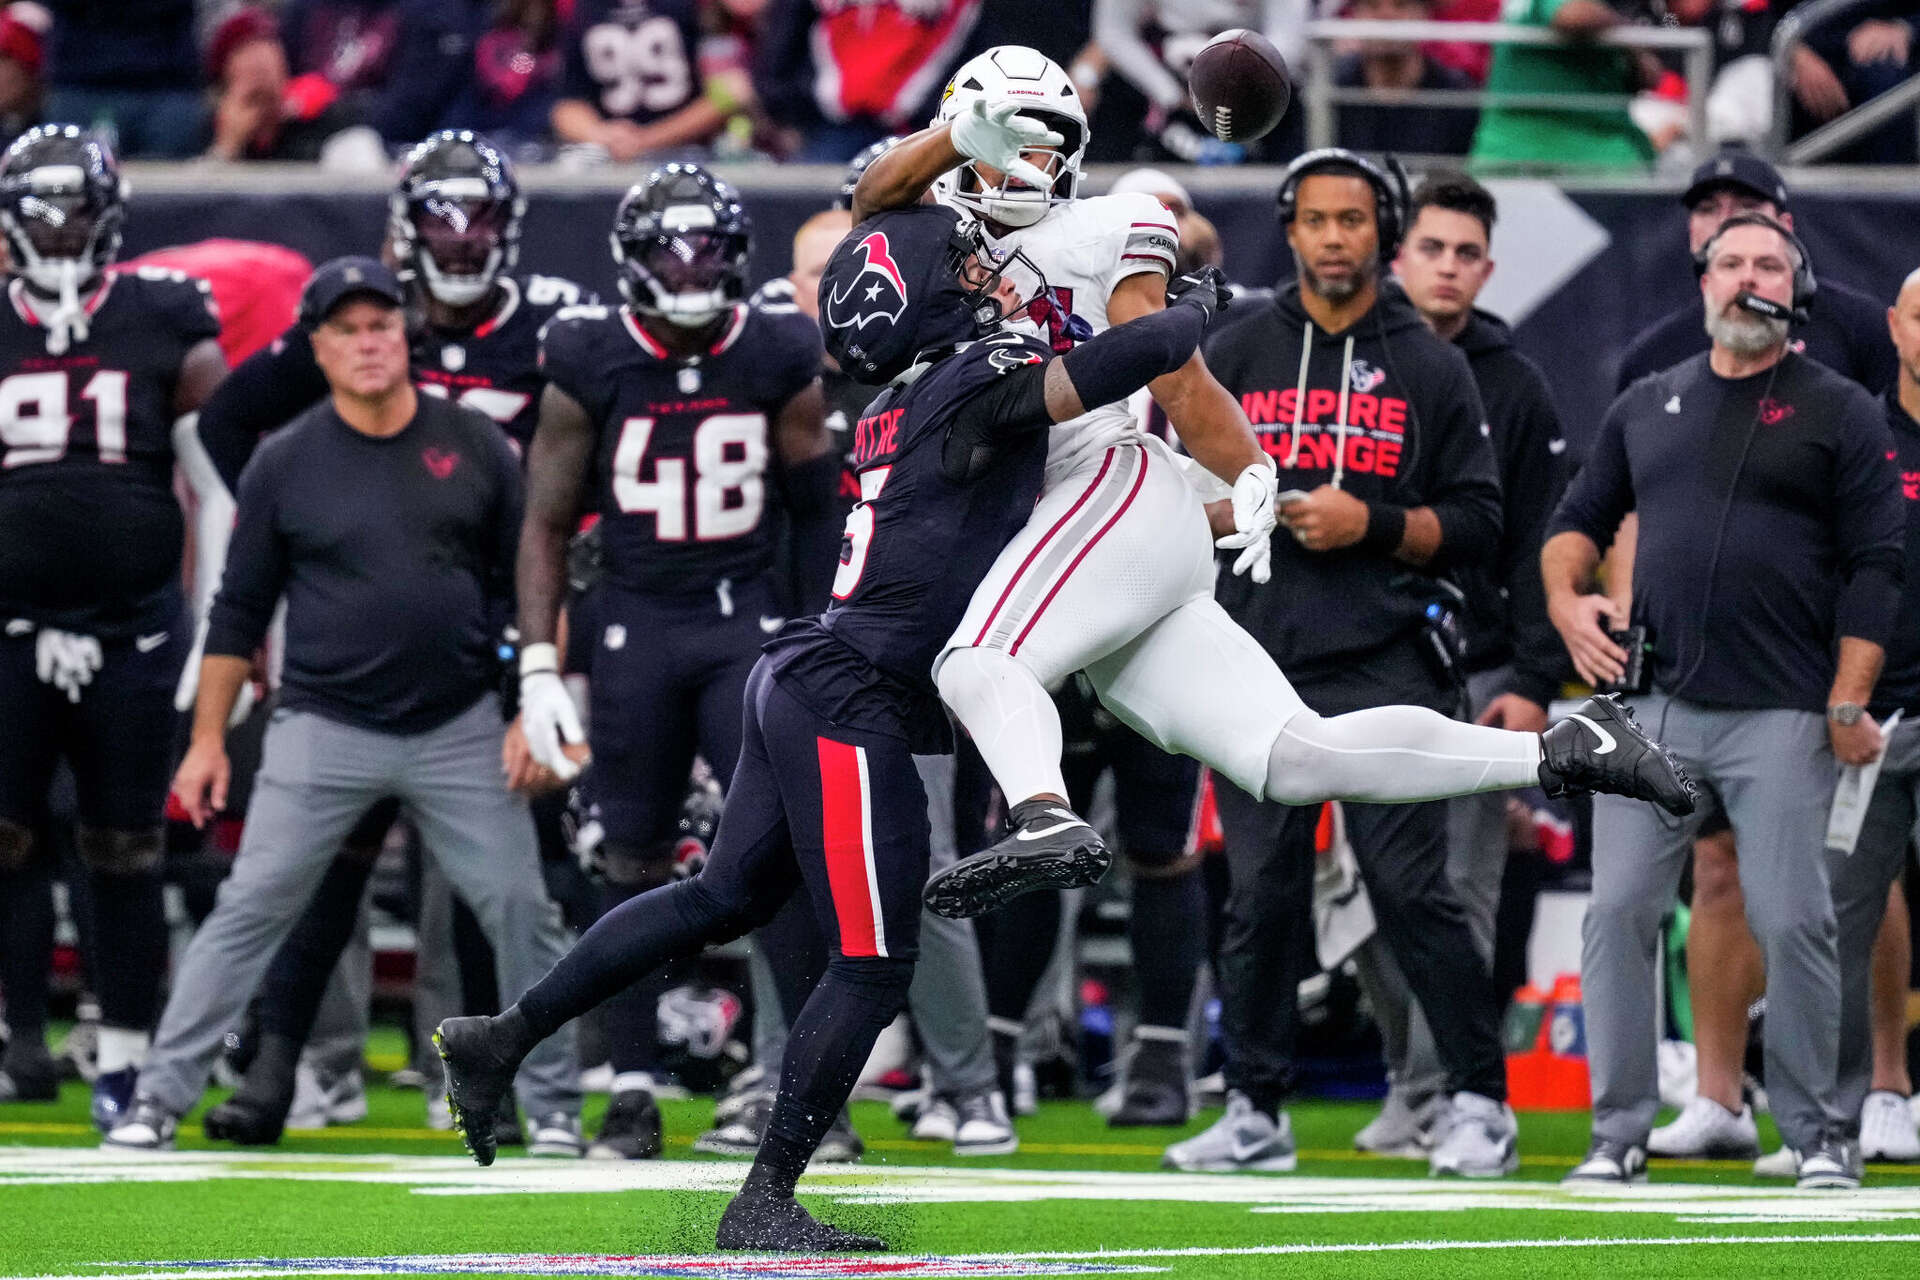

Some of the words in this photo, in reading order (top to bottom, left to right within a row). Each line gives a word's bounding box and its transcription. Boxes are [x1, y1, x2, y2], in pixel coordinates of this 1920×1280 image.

[582, 15, 692, 114] 99
[0, 369, 131, 469] 91
[855, 408, 905, 465] PITRE
[1241, 388, 1407, 435] INSPIRE
[613, 413, 769, 542] 48
[1256, 432, 1403, 478] HANGE
